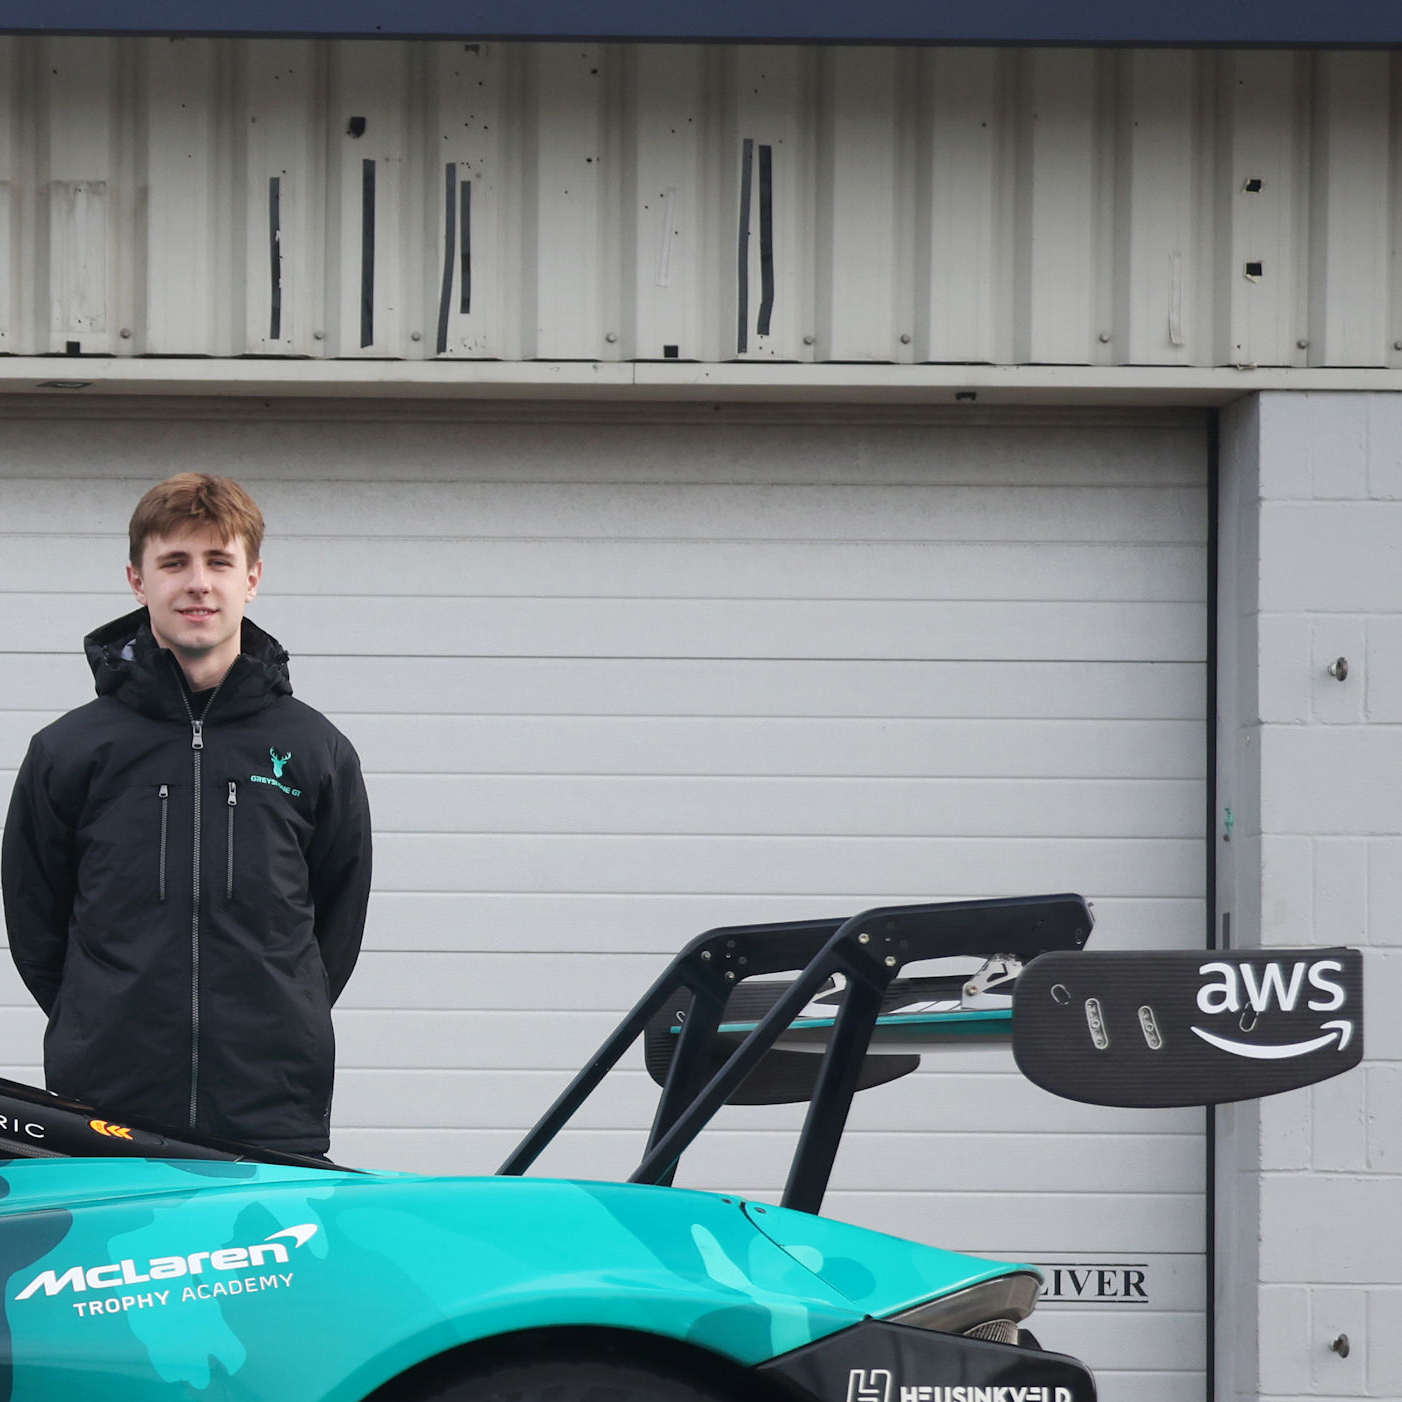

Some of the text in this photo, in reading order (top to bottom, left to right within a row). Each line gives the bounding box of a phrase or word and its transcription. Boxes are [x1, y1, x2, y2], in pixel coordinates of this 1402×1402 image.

[1196, 960, 1347, 1013] aws
[14, 1242, 290, 1301] McLaren
[72, 1272, 294, 1318] TROPHY ACADEMY
[1040, 1268, 1149, 1298] IVER
